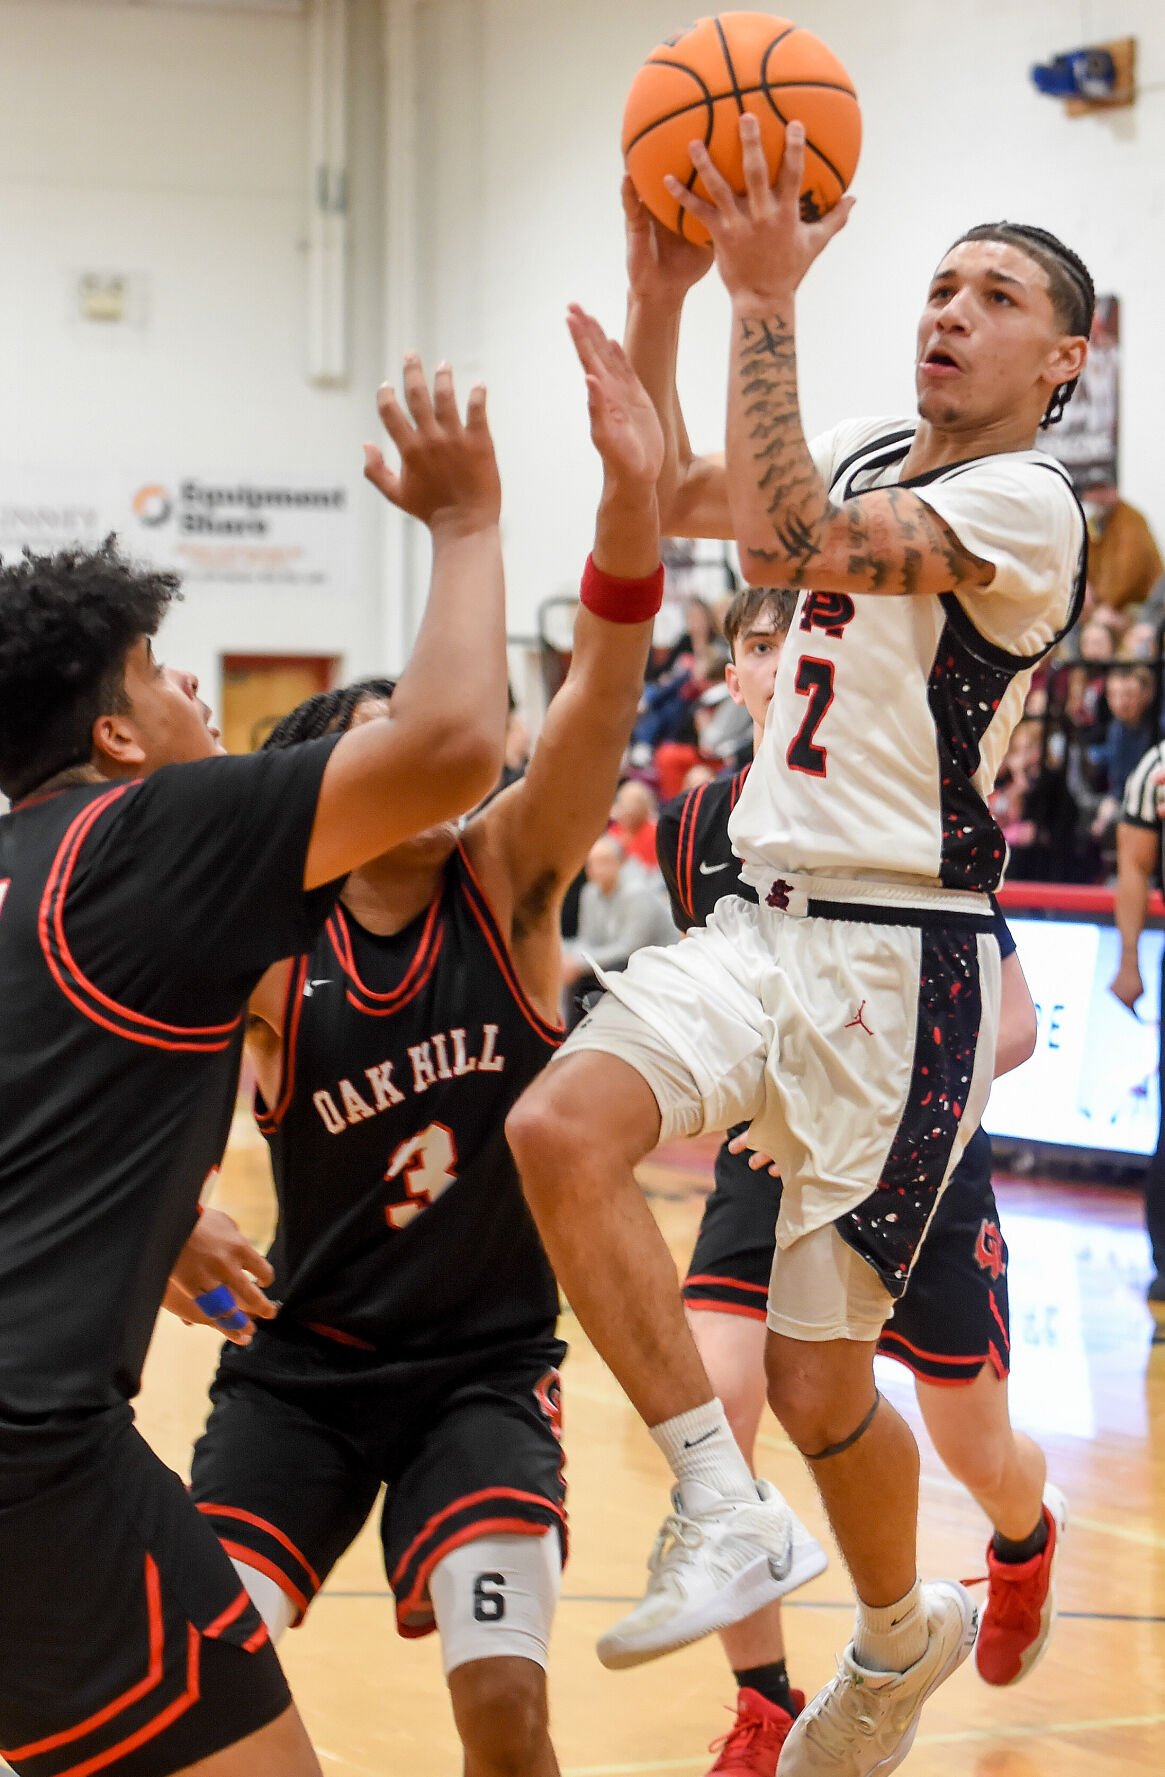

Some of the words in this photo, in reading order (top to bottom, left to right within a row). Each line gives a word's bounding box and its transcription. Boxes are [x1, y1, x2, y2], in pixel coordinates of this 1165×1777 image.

[181, 481, 346, 510] Equipment
[181, 513, 267, 536] Share
[787, 655, 835, 777] 2
[312, 1060, 406, 1135] OAK
[407, 1023, 505, 1093] HILL
[384, 1120, 458, 1230] 3
[474, 1572, 506, 1621] 6
